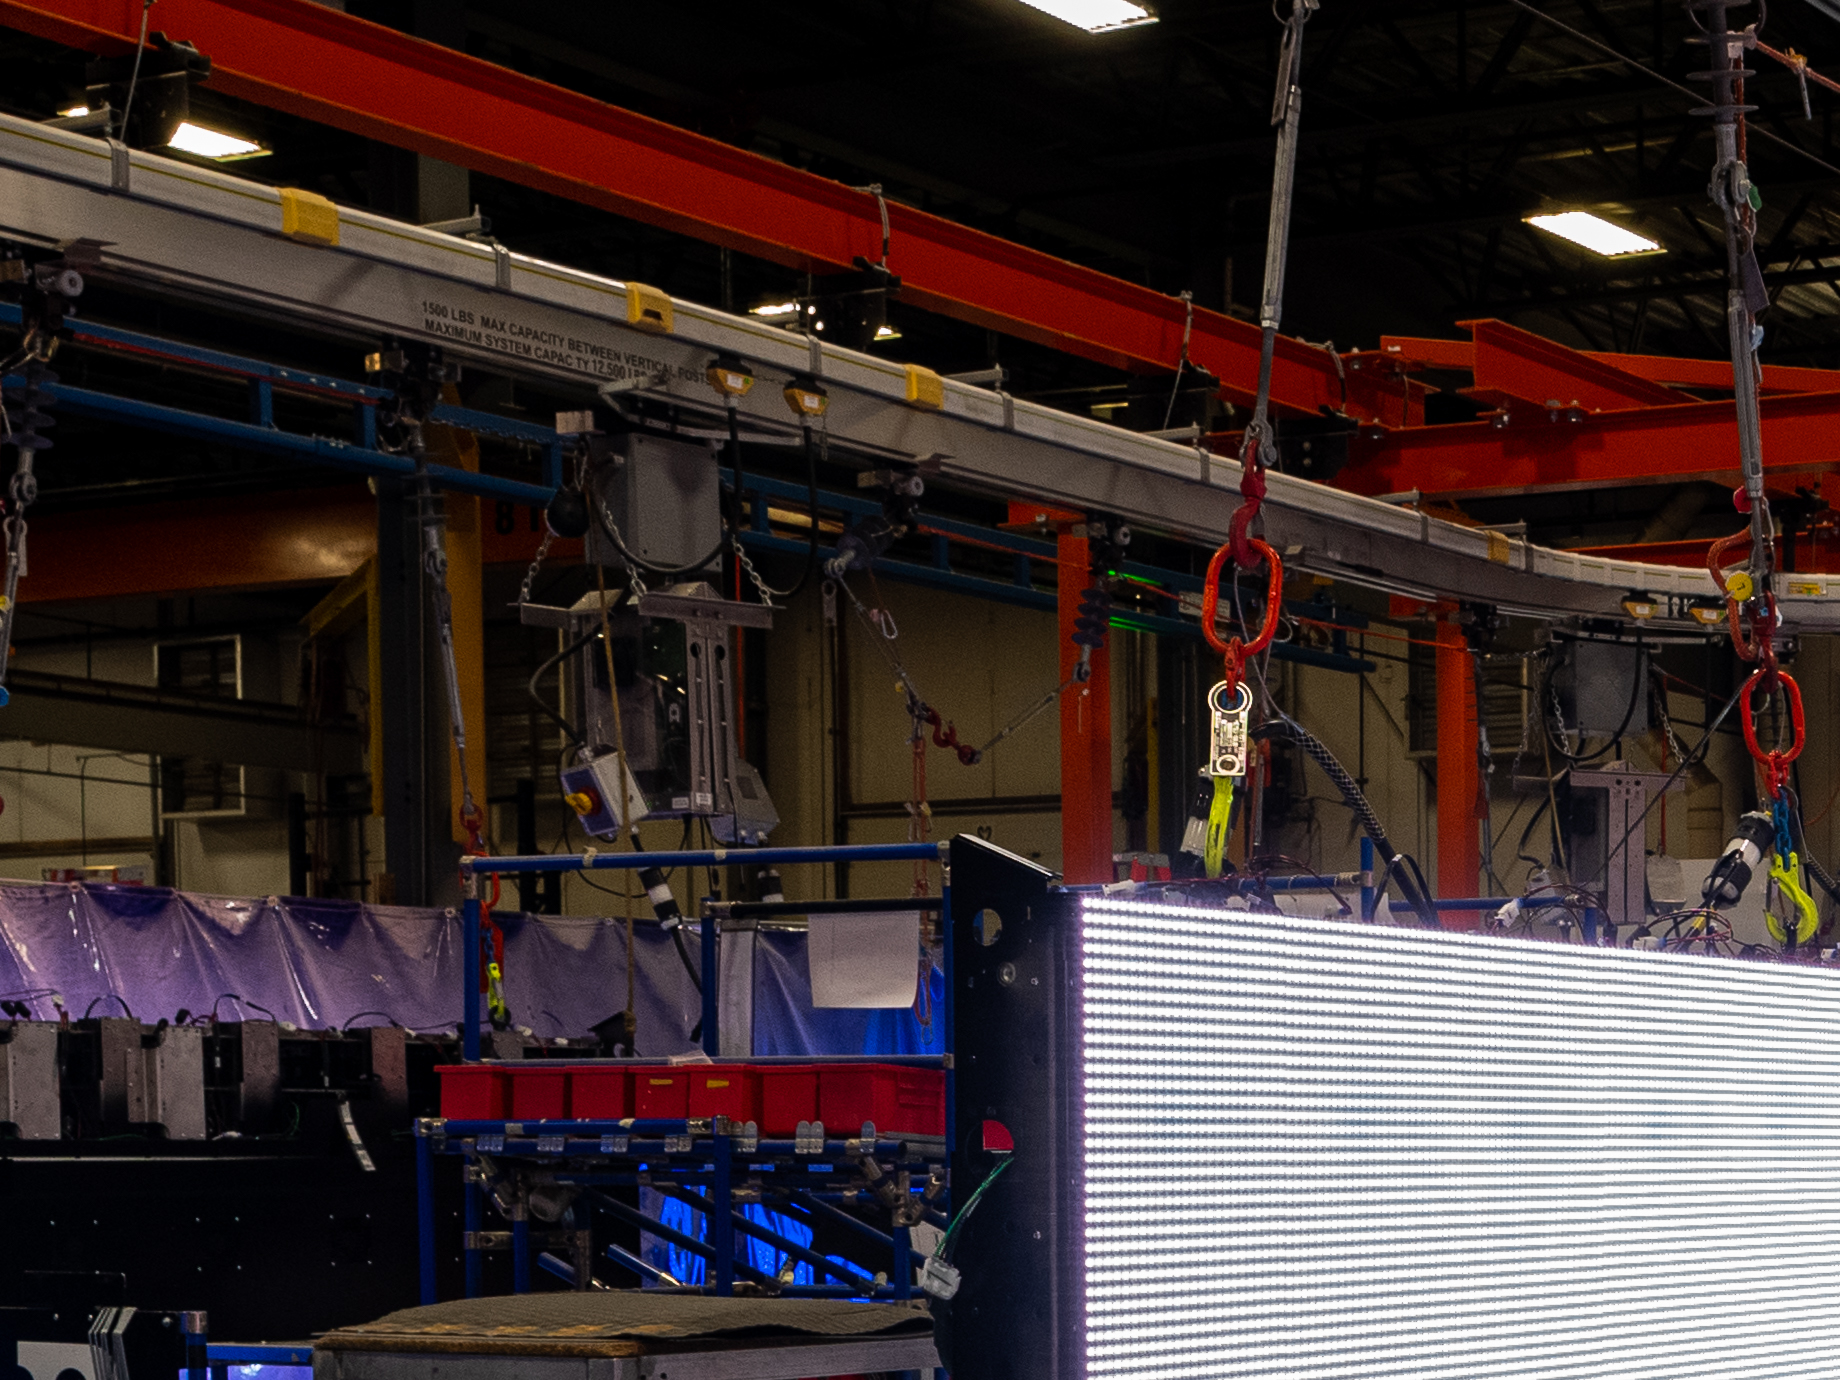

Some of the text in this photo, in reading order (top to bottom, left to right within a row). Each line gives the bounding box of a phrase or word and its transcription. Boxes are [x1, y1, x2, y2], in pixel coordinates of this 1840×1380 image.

[422, 301, 449, 319] 1500
[480, 315, 507, 333] MAX
[508, 323, 565, 348] CAPACITY
[567, 338, 621, 362] BETWEEN
[623, 351, 673, 374] VERTICAL
[424, 318, 482, 344] MAXIMUM
[484, 333, 532, 356] SYSTEM
